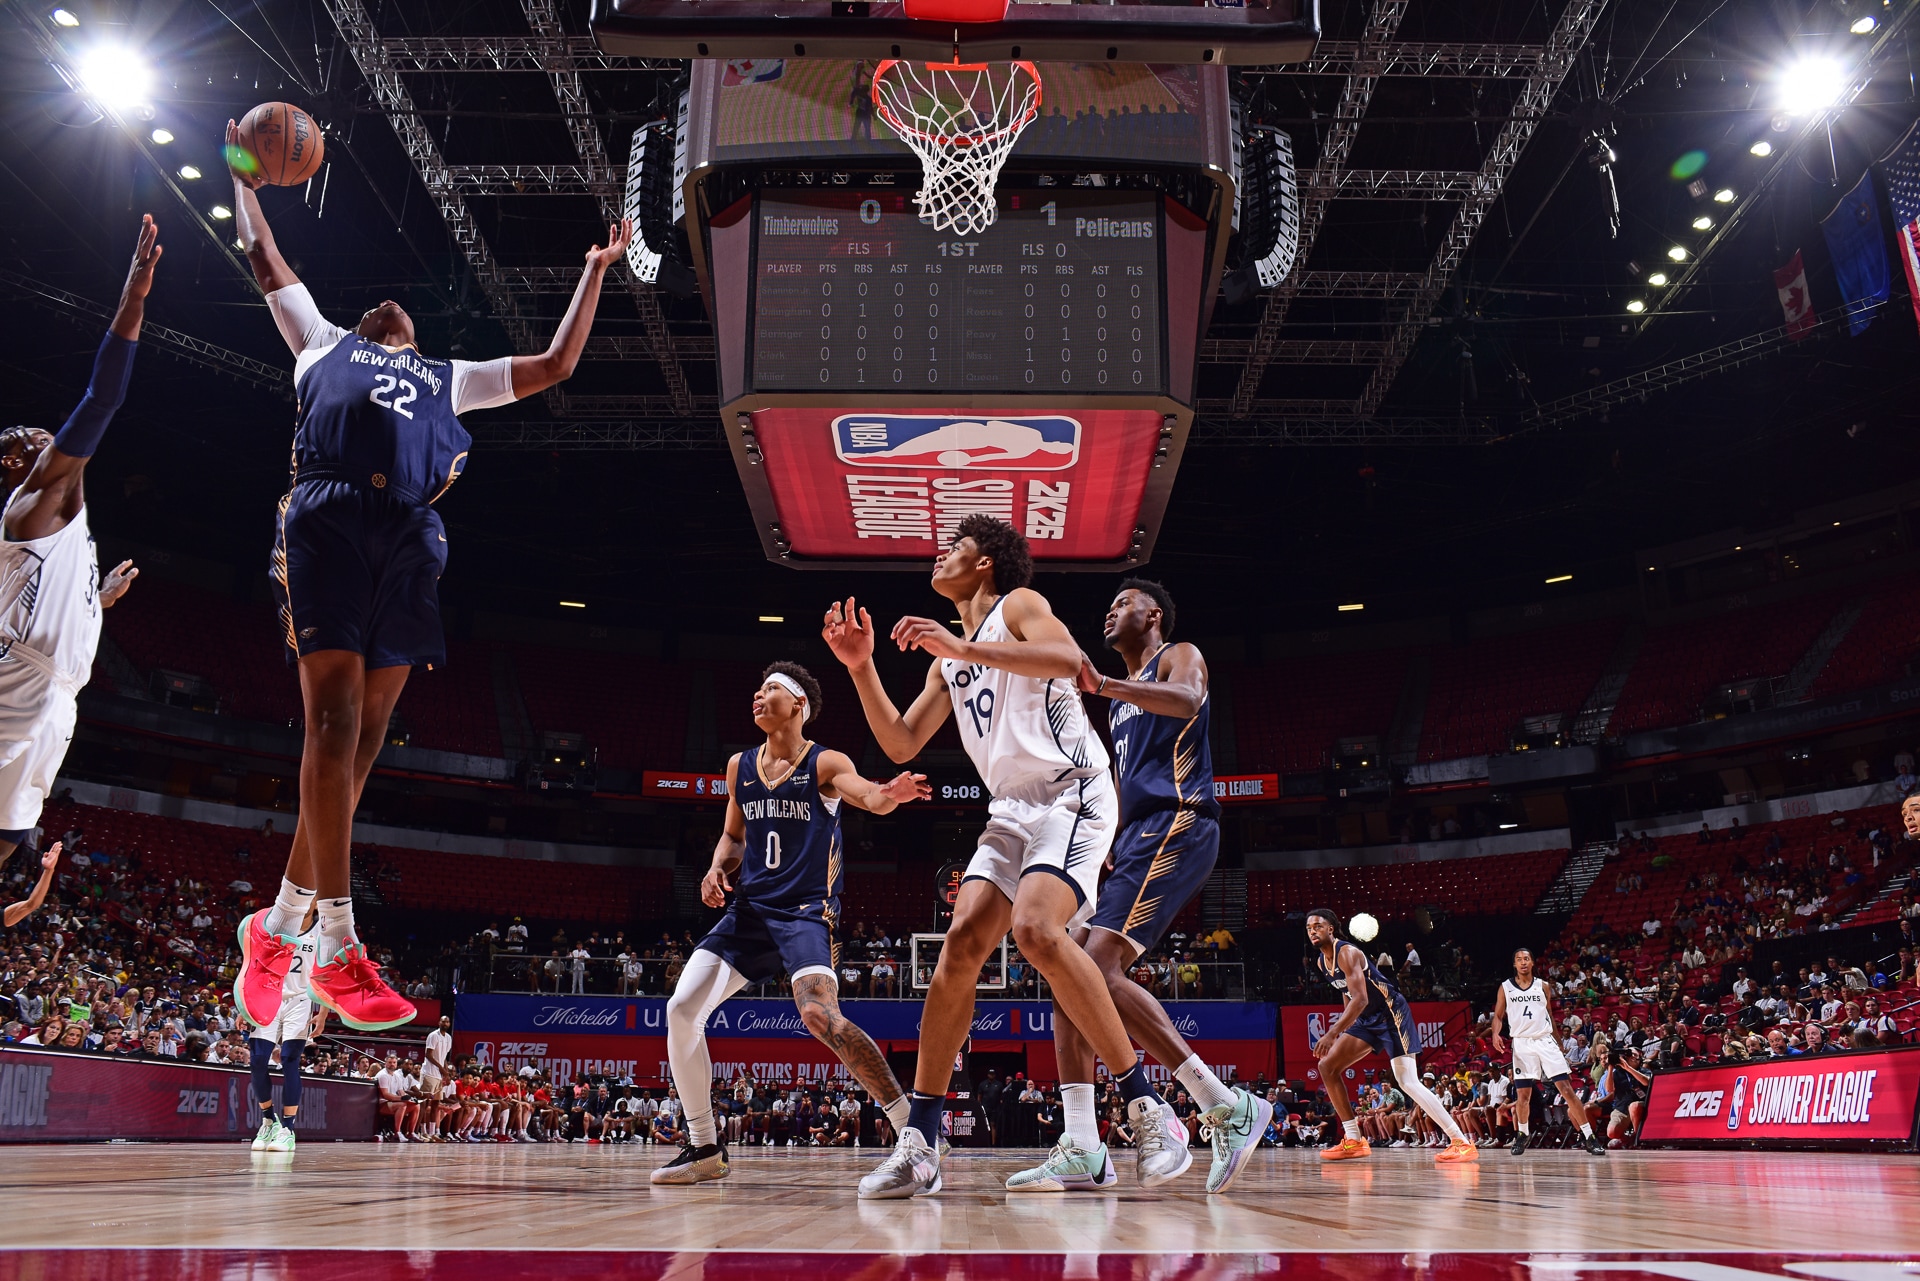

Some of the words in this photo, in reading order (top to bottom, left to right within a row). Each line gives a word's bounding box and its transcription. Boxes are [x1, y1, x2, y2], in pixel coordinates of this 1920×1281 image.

[290, 110, 309, 162] Wilson
[860, 199, 881, 224] 0
[1040, 201, 1056, 226] 1
[763, 215, 839, 236] Timberwolves
[1075, 217, 1153, 238] Pelicans
[848, 243, 870, 255] FLS
[885, 242, 892, 256] 1
[937, 242, 980, 257] 1ST
[1022, 243, 1044, 256] FLS
[1055, 243, 1067, 257] 0
[767, 264, 802, 273] PLAYER
[819, 264, 837, 273] PTS
[854, 264, 873, 273] RBS
[890, 264, 908, 273] AST
[925, 264, 942, 274] FLS
[968, 265, 1003, 274] PLAYER
[1020, 265, 1038, 275] PTS
[1055, 265, 1074, 275] RBS
[1091, 266, 1110, 275] AST
[1127, 266, 1143, 276] FLS
[822, 282, 831, 296] 0
[858, 282, 868, 296] 0
[894, 282, 904, 296] 0
[929, 282, 939, 296] 0
[1024, 283, 1034, 297] 0
[1061, 284, 1070, 297] 0
[1097, 284, 1106, 298] 0
[1131, 284, 1140, 298] 0
[821, 303, 831, 318] 0
[859, 303, 867, 318] 1
[894, 303, 903, 318] 0
[929, 303, 938, 318] 0
[1025, 304, 1034, 318] 0
[1061, 304, 1070, 318] 0
[1097, 305, 1106, 318] 0
[1131, 305, 1140, 319] 0
[821, 325, 830, 339] 0
[857, 325, 867, 339] 0
[894, 325, 903, 339] 0
[929, 325, 938, 339] 0
[1025, 326, 1034, 340] 0
[1062, 327, 1070, 341] 1
[1097, 327, 1107, 341] 0
[1132, 328, 1141, 342] 0
[820, 347, 830, 361] 0
[857, 347, 866, 361] 0
[893, 347, 902, 361] 0
[929, 347, 937, 361] 1
[1025, 348, 1034, 362] 1
[1061, 348, 1071, 362] 0
[1098, 349, 1107, 362] 0
[1132, 349, 1141, 363] 0
[350, 350, 388, 367] NEW
[390, 355, 442, 396] ORLEANS
[820, 368, 829, 382] 0
[857, 368, 865, 382] 1
[893, 368, 902, 382] 0
[928, 368, 937, 382] 0
[1025, 369, 1034, 383] 0
[1061, 370, 1071, 383] 0
[1098, 370, 1107, 384] 0
[1132, 370, 1142, 384] 0
[369, 374, 418, 421] 22
[849, 422, 889, 448] NBA
[846, 474, 933, 540] LEAGUE
[1025, 479, 1071, 540] 2K26
[964, 688, 995, 739] 19
[657, 780, 689, 789] 2K26
[942, 785, 980, 799] 9:08
[1229, 780, 1264, 796] LEAGUE
[742, 799, 765, 821] NEW
[767, 798, 811, 822] ORLEANS
[765, 830, 782, 870] 0
[1510, 995, 1541, 1003] WOLVES
[533, 1006, 621, 1027] Michelob
[1523, 1005, 1533, 1020] 4
[499, 1042, 549, 1055] 2K26
[751, 1062, 793, 1085] STARS
[797, 1063, 830, 1085] PLAY
[177, 1090, 219, 1114] 2K26
[1674, 1090, 1724, 1118] 2K26
[1748, 1074, 1814, 1124] SUMMER
[1811, 1070, 1877, 1124] LEAGUE
[954, 1117, 976, 1127] SUMMER
[954, 1127, 973, 1136] LEAGUE
